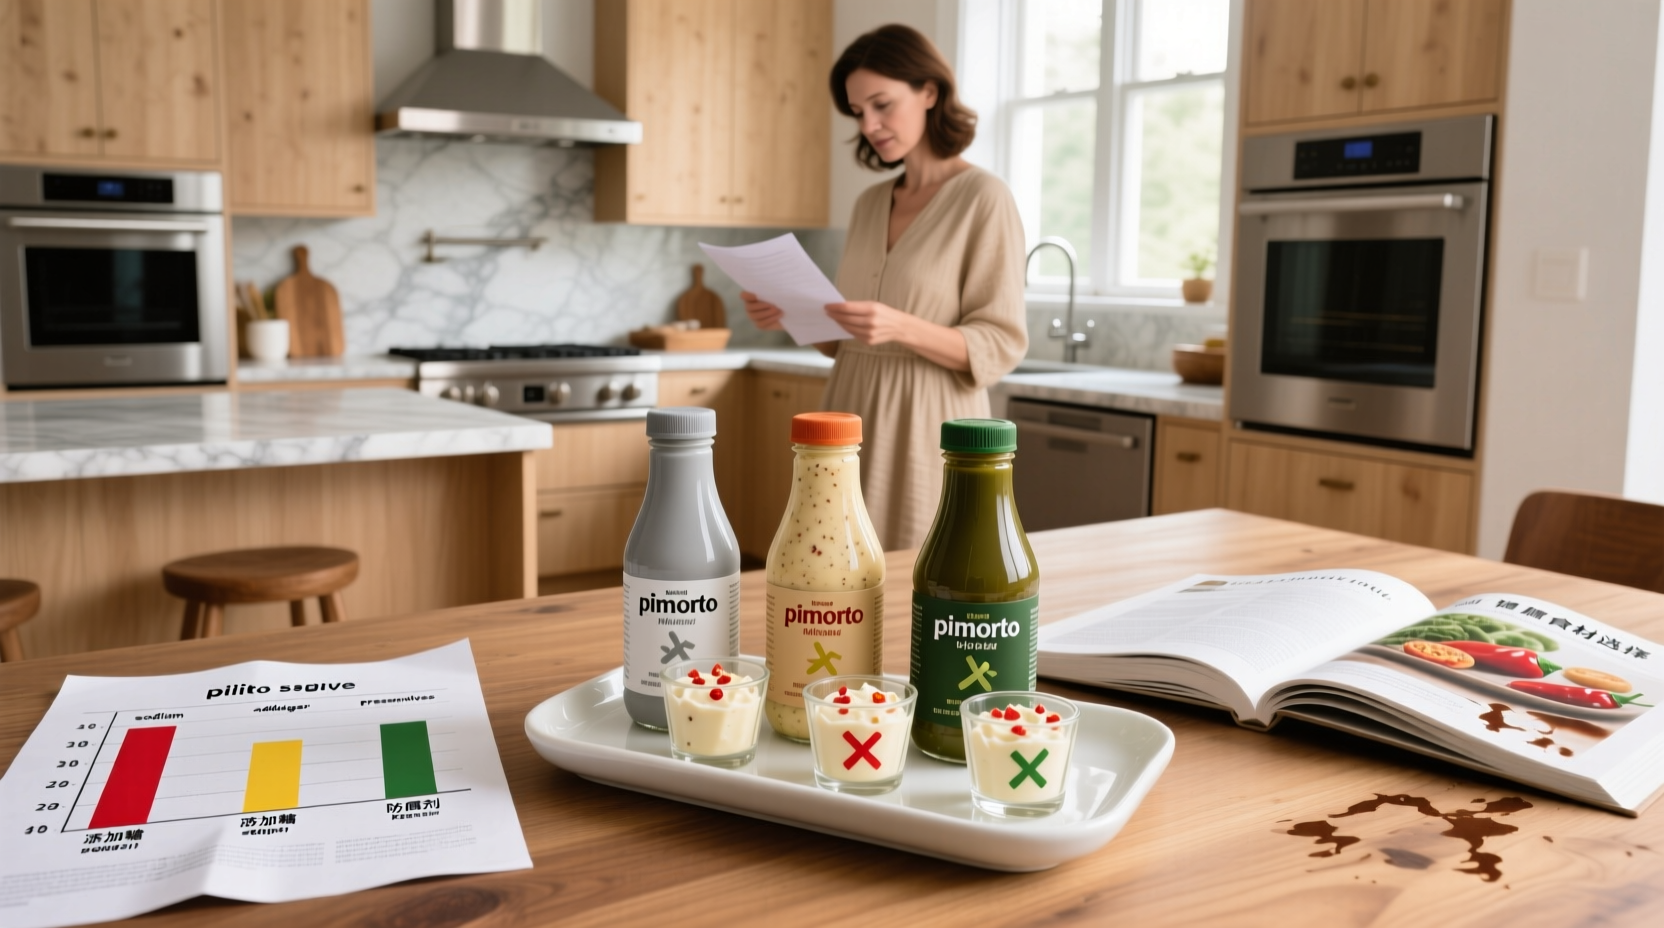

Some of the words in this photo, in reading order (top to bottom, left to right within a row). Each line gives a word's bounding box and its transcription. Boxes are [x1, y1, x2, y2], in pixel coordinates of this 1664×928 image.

[639, 592, 718, 616] pimorto
[784, 604, 864, 628] pimorto
[933, 615, 1020, 640] pimorto
